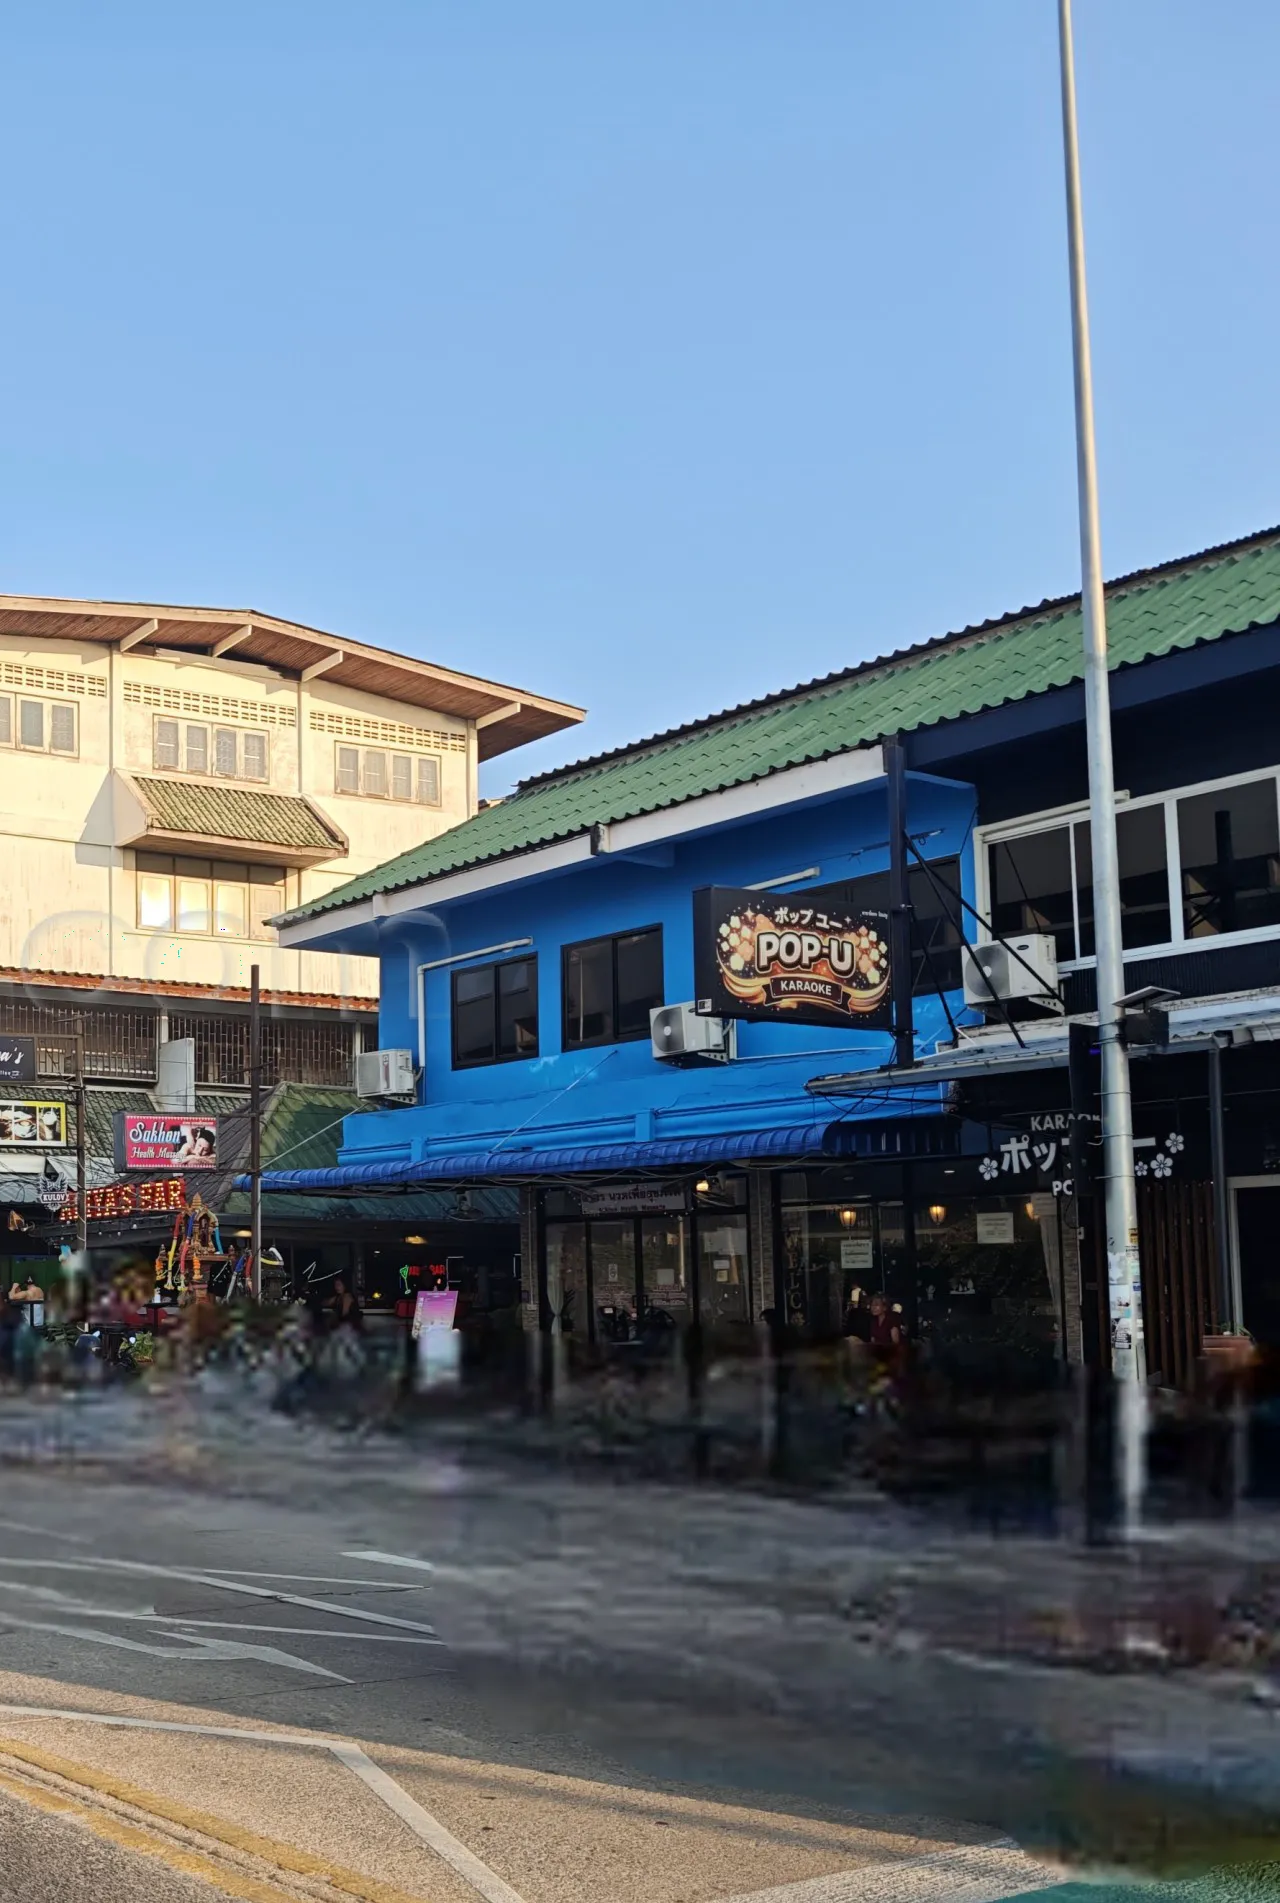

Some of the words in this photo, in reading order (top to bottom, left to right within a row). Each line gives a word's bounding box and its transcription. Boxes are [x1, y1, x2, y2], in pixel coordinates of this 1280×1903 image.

[758, 932, 853, 973] POP-U
[780, 980, 832, 996] KARAOKE
[129, 1121, 181, 1143] Sakhon
[130, 1146, 155, 1158] Health
[42, 1193, 66, 1202] KULOV
